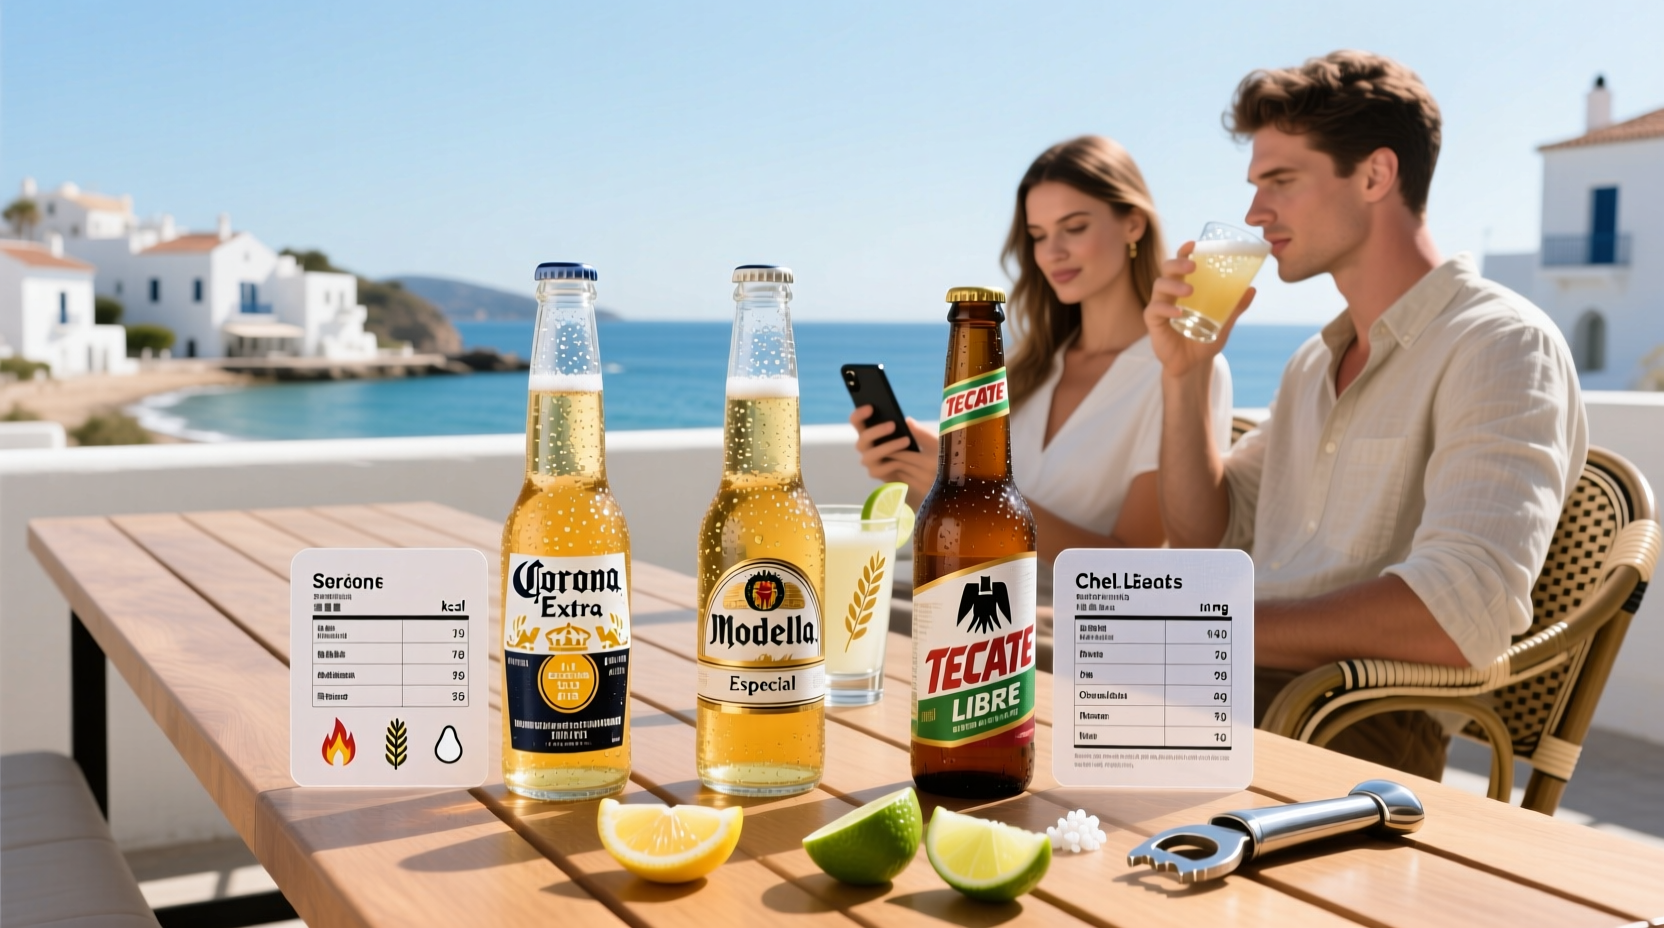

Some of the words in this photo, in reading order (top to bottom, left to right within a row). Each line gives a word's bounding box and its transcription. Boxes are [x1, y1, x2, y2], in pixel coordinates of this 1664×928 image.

[946, 381, 1005, 417] TECATE
[541, 596, 603, 618] Extra
[925, 623, 1034, 694] TECATE
[729, 675, 796, 696] Especial
[952, 681, 1021, 722] LIBRE
